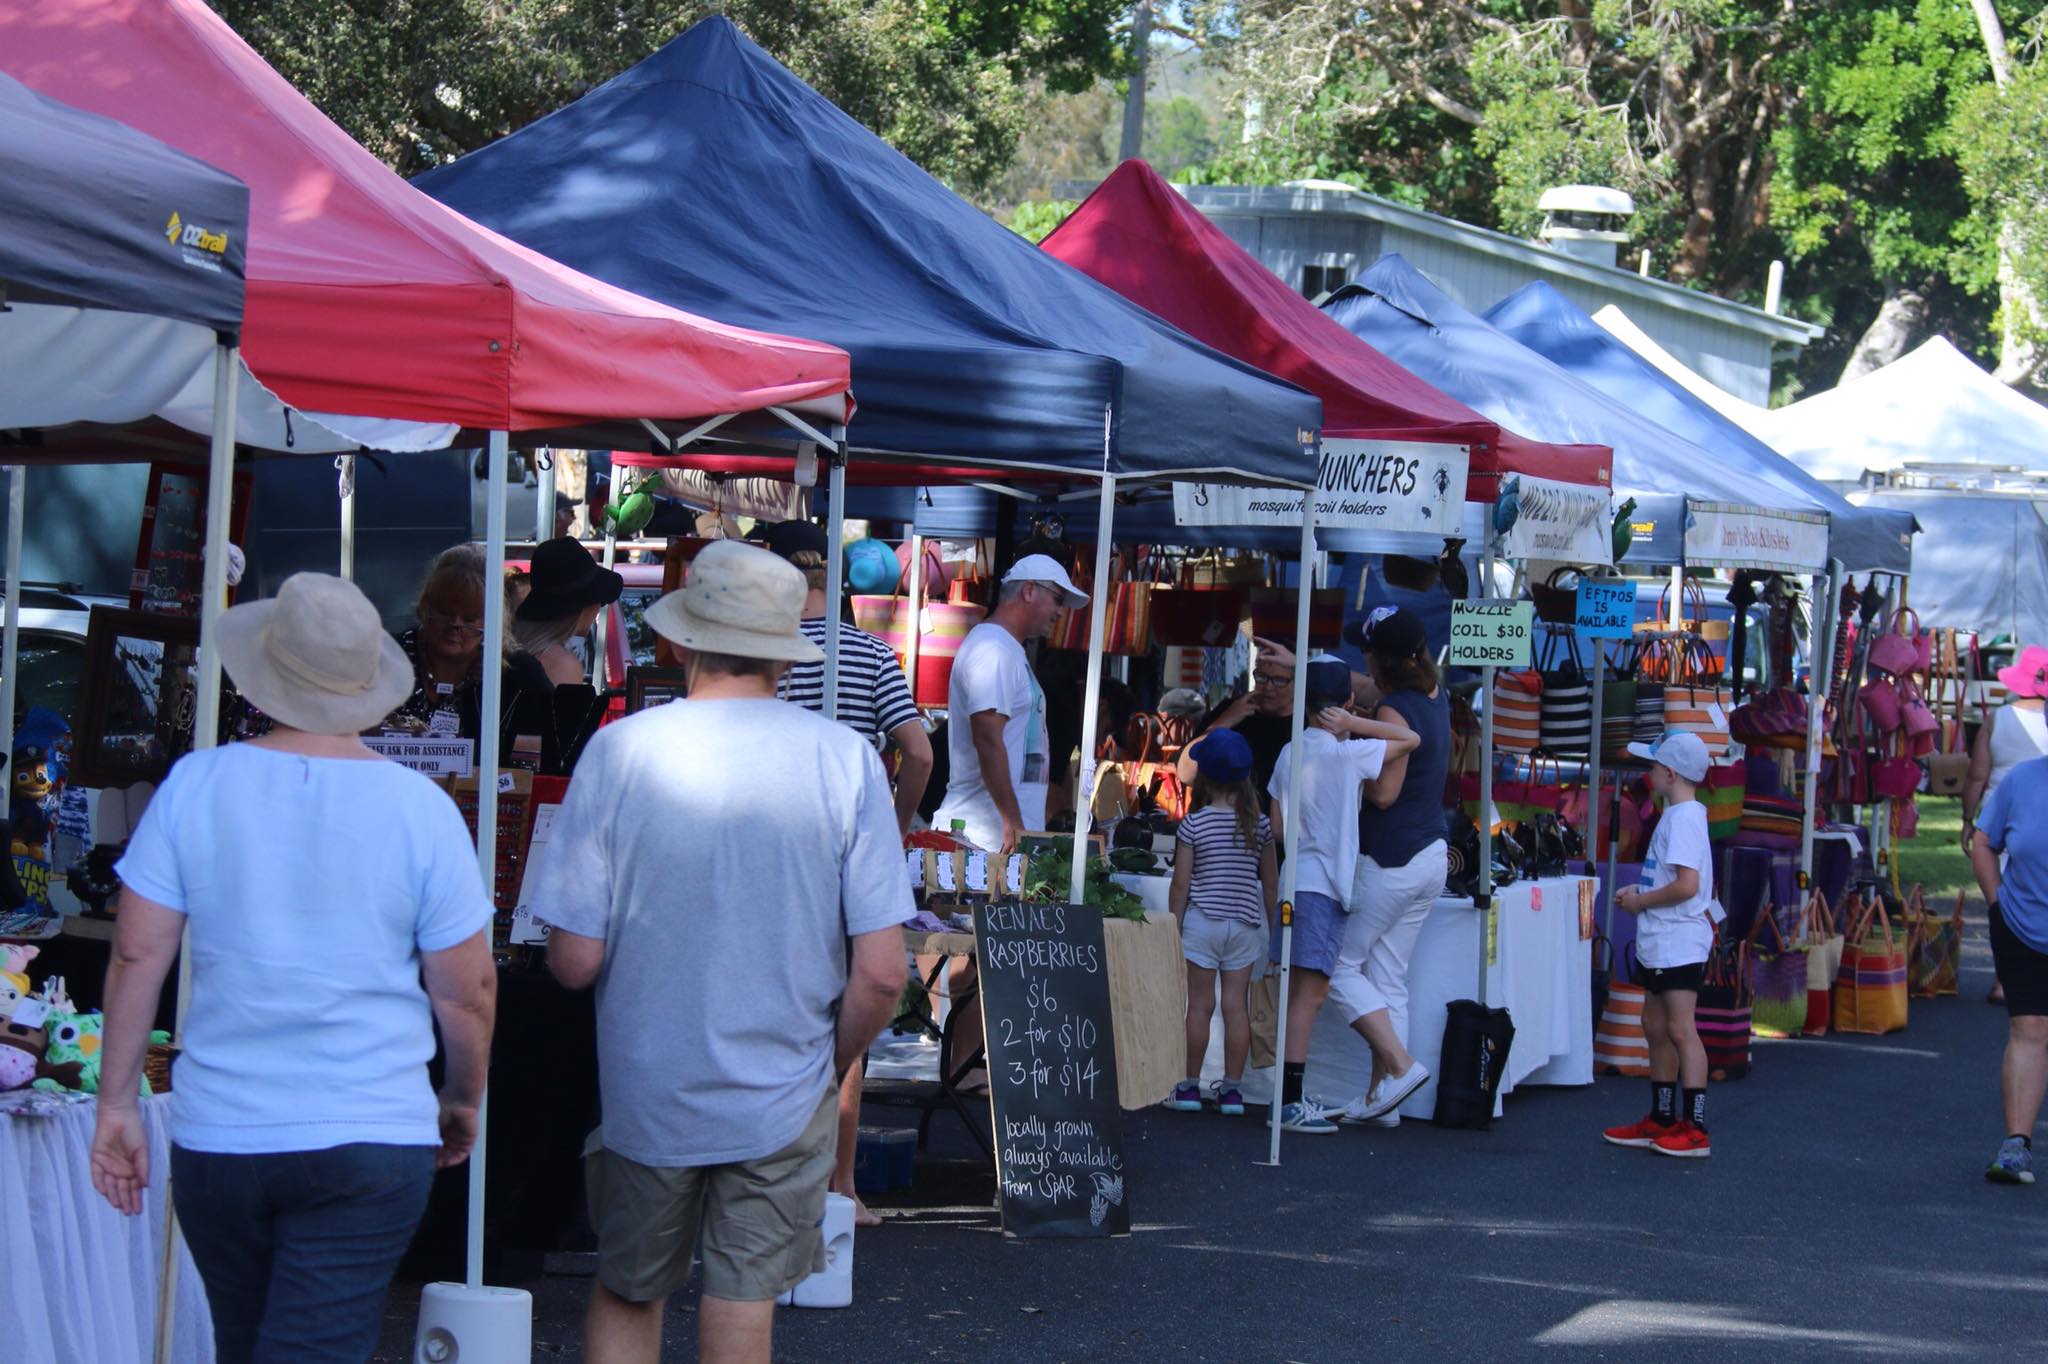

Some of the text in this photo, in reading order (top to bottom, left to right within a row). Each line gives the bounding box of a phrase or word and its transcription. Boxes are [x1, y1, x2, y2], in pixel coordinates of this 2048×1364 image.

[182, 223, 228, 254] OZtrail
[1337, 500, 1388, 516] holders
[1585, 587, 1633, 602] EFTPOS
[1594, 602, 1608, 613] IS
[1452, 624, 1487, 637] COIL
[1577, 615, 1627, 627] AVAILABLE
[1452, 646, 1514, 660] HOLDERS
[387, 745, 402, 756] ASK
[403, 745, 420, 756] FOR
[422, 745, 466, 757] ASSISTANCE
[420, 760, 440, 771] ONLY
[984, 904, 1066, 934] RENAE'S
[986, 937, 1098, 978] RASPBERRIES
[1026, 976, 1057, 1017] $6
[1000, 1014, 1096, 1056] 2 for $10
[1008, 1056, 1101, 1100] 3 for $14
[1005, 1114, 1047, 1150] locally
[1004, 1143, 1124, 1175] always available
[1002, 1170, 1033, 1199] from
